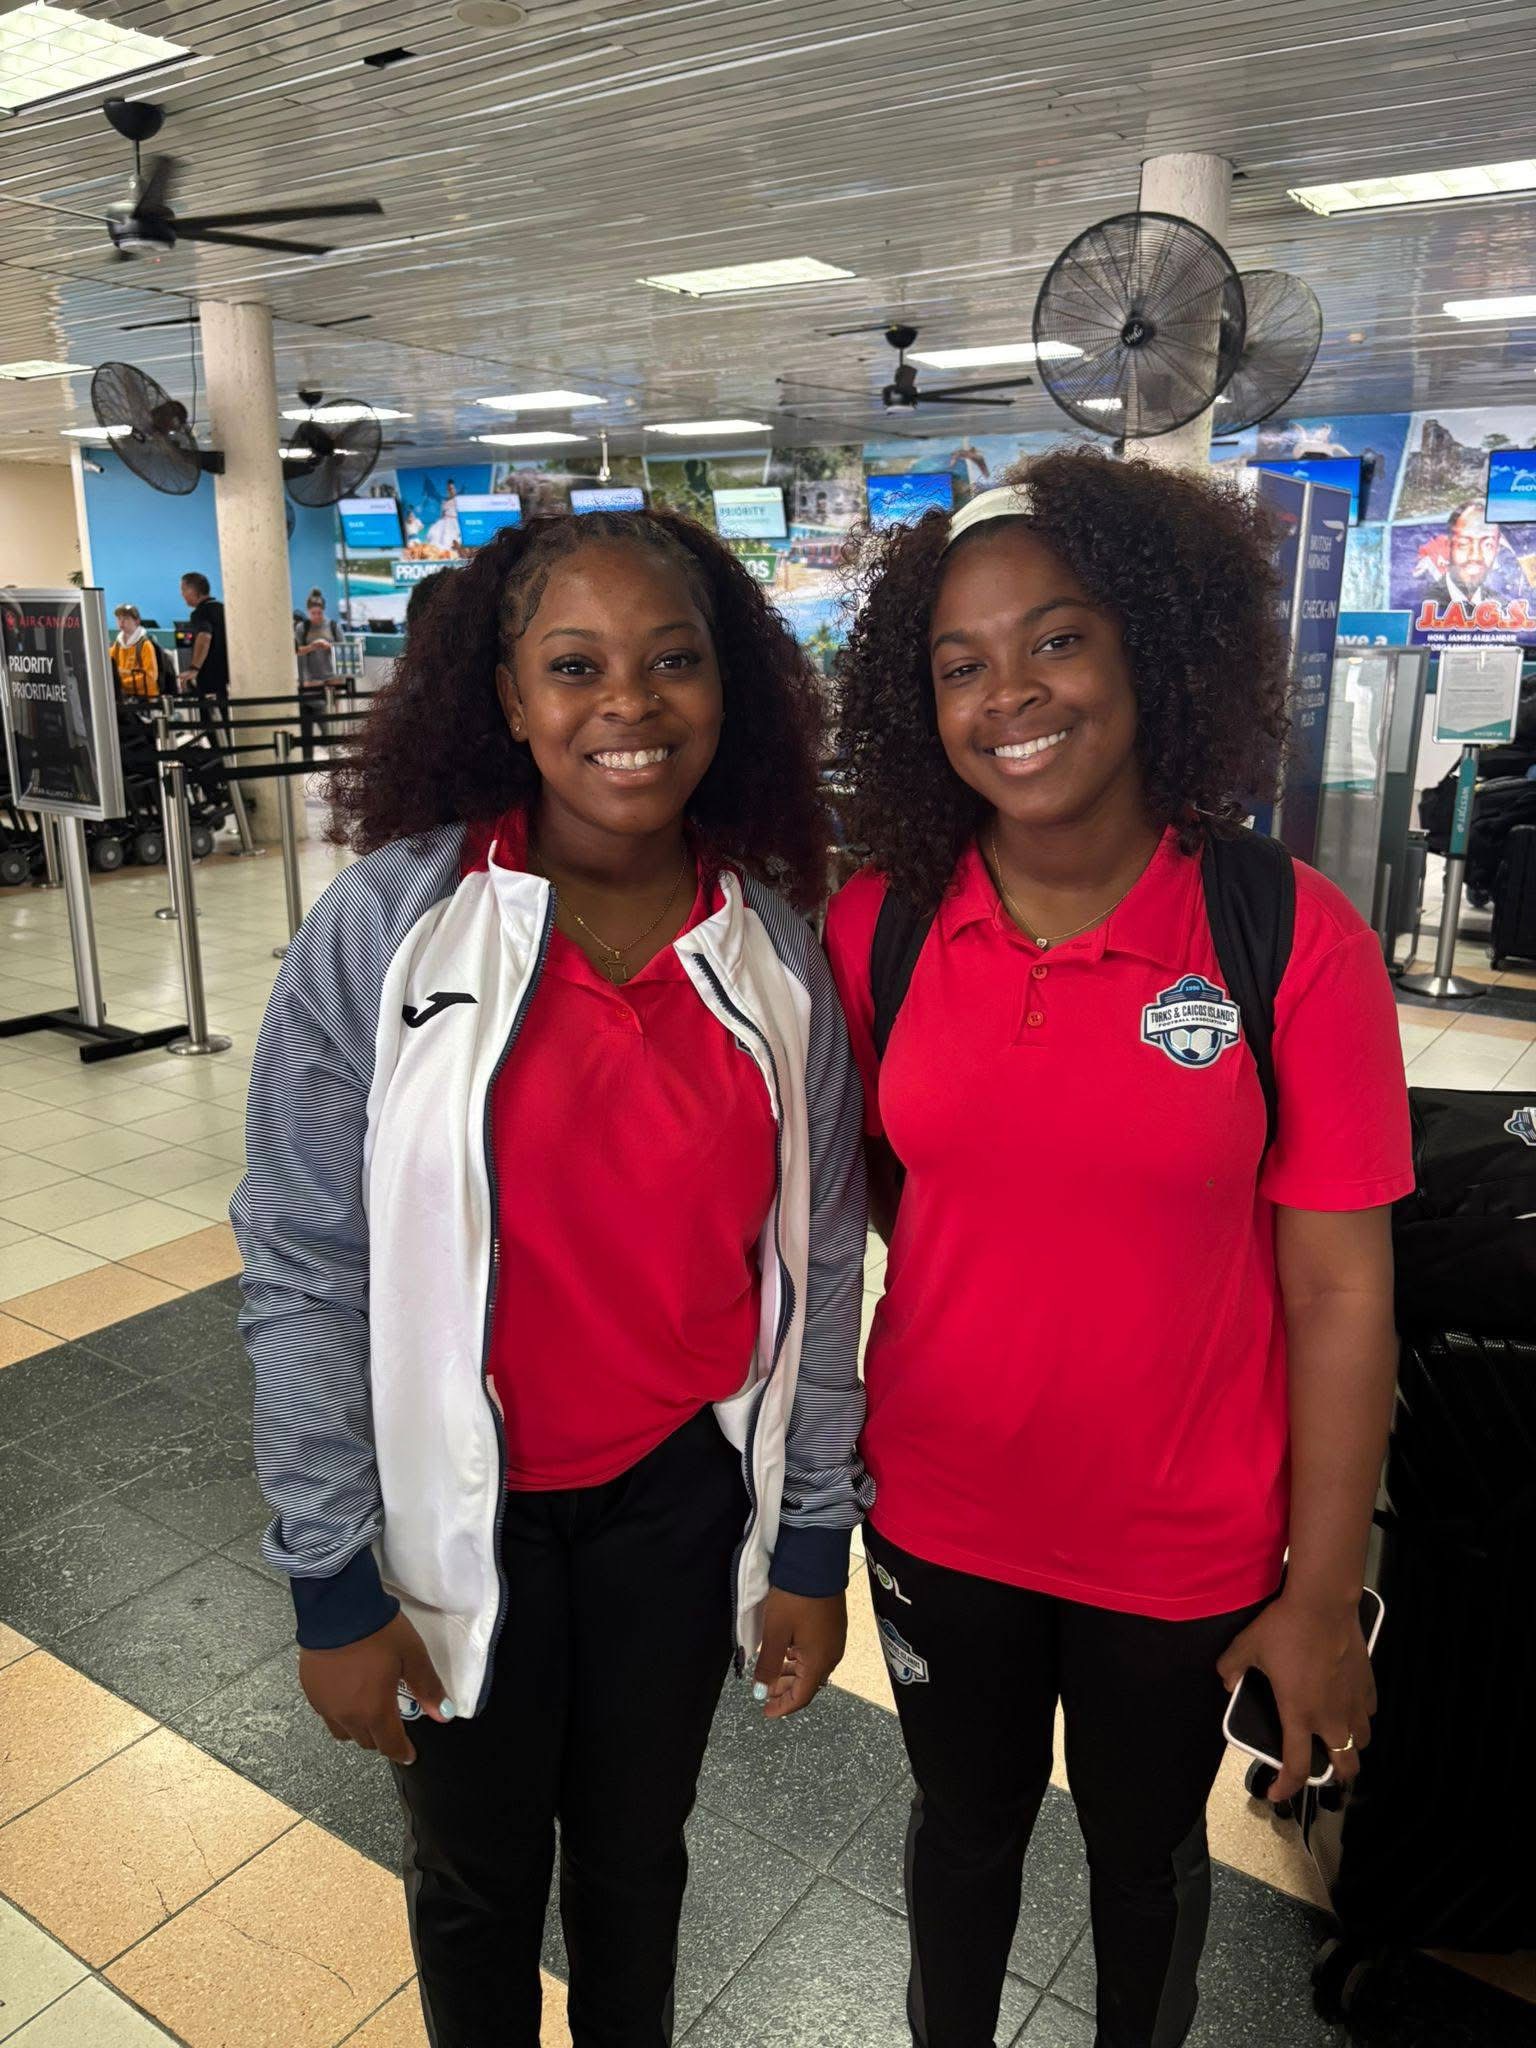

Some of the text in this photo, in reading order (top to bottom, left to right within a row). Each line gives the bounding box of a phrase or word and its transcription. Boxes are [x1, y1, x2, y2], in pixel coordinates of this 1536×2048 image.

[1302, 599, 1337, 619] CHECK-IN
[20, 615, 80, 629] AIR CANADA
[8, 655, 53, 675] PRIORITY
[12, 681, 67, 702] PRIORITAIRE
[1150, 1004, 1235, 1024] TURKS & CAICOS ISLANDS
[1158, 1018, 1189, 1028] FOOTBALL
